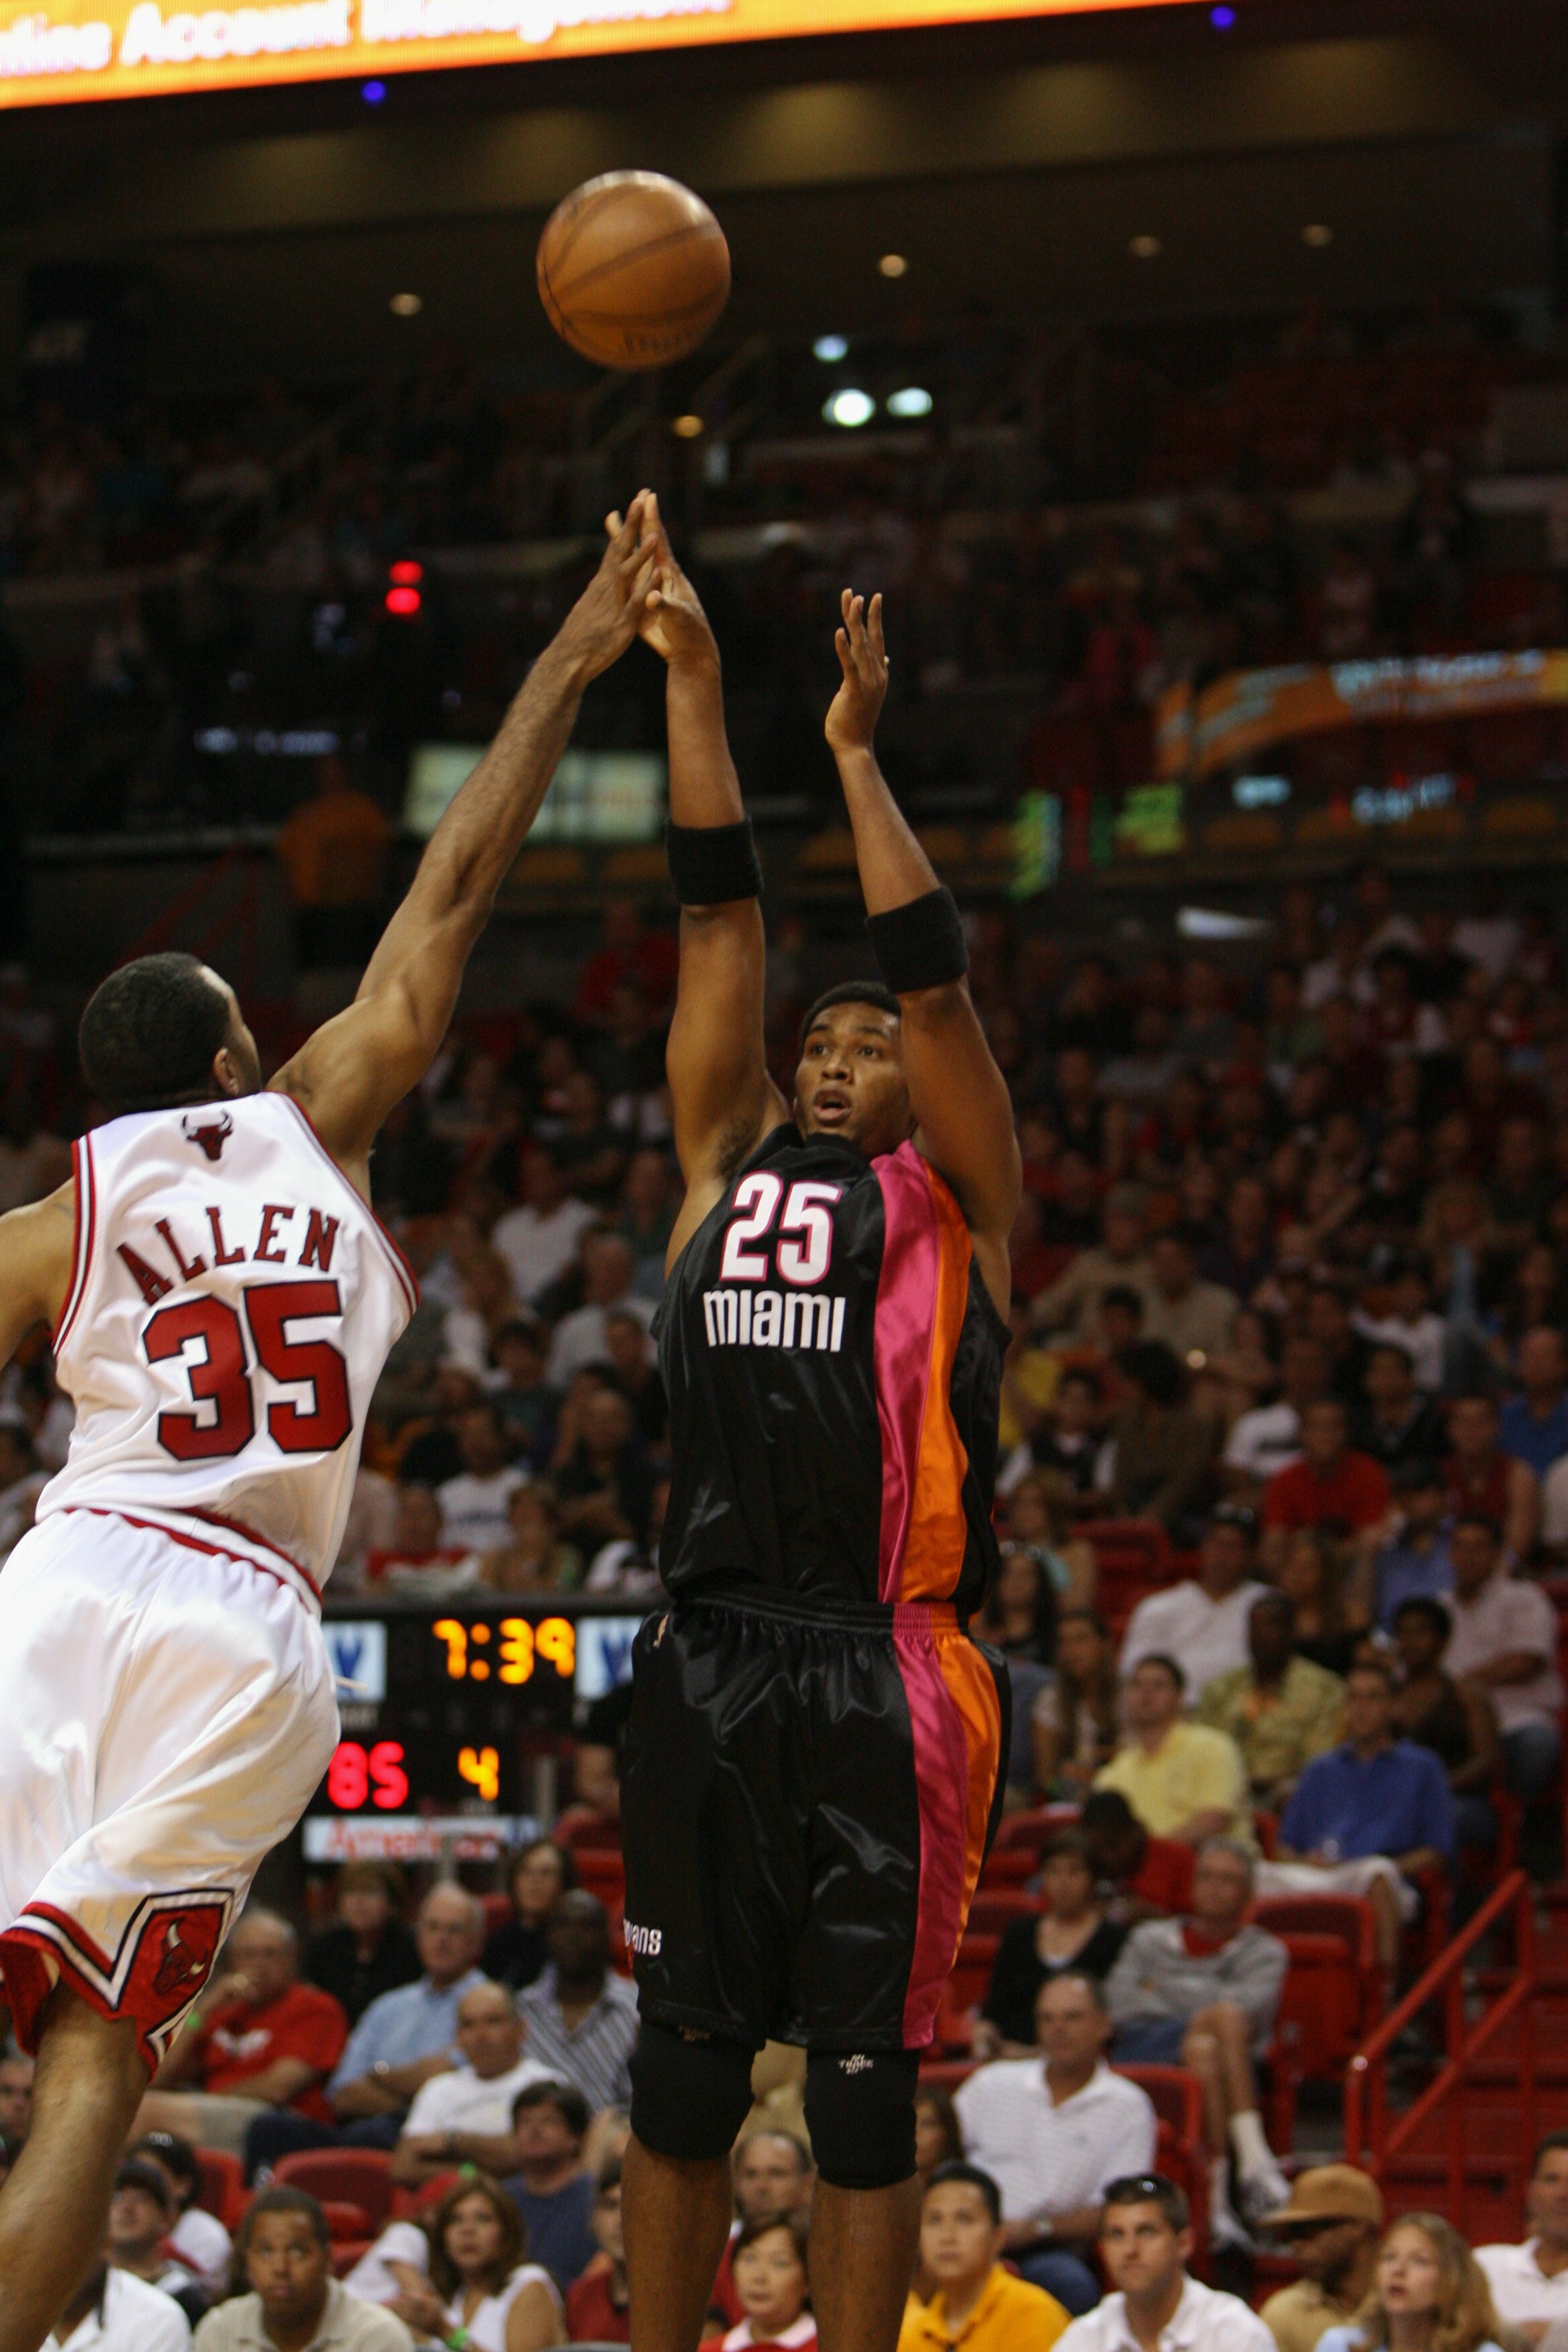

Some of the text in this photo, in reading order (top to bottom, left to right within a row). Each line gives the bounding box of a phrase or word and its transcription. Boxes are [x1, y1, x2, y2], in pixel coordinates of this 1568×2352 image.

[116, 1205, 340, 1306] ALLEN
[719, 1169, 844, 1286] 25
[142, 1279, 353, 1462] 35
[432, 1617, 577, 1685] 7:39
[328, 1741, 409, 1810] 85
[458, 1746, 499, 1802] 4
